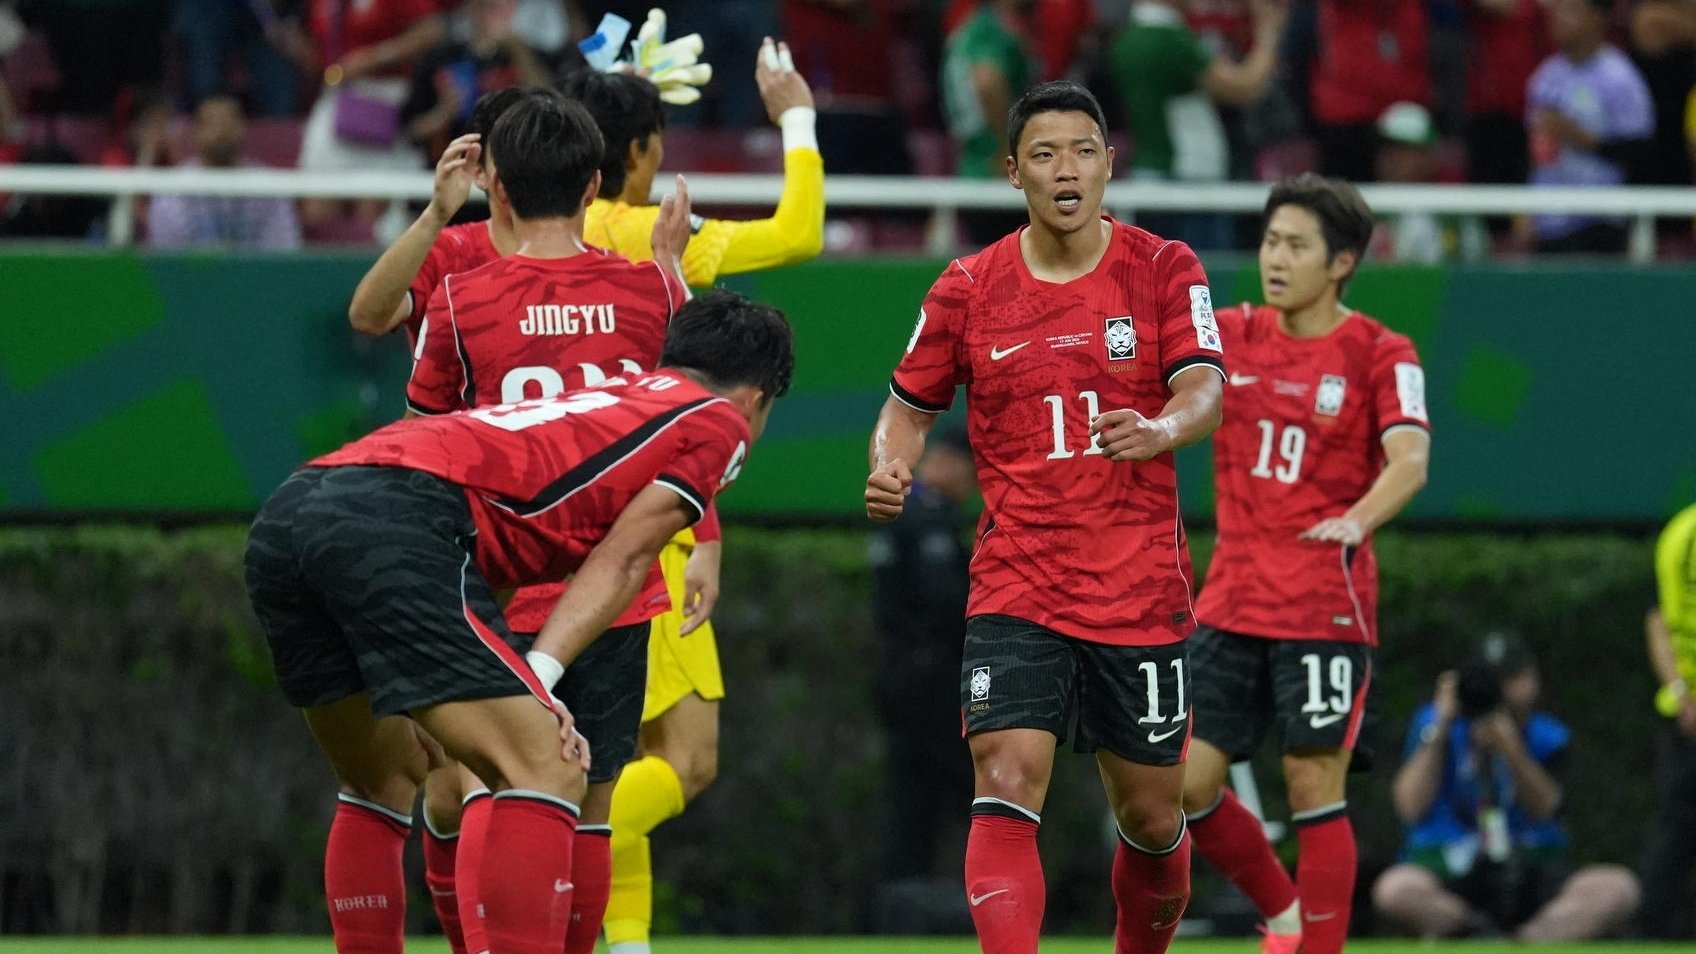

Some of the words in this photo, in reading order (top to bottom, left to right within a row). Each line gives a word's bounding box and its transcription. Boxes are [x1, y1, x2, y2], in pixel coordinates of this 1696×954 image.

[519, 303, 616, 336] JINGYU
[1108, 364, 1137, 373] KOREA
[1044, 390, 1104, 461] 11
[1251, 419, 1306, 484] 19
[1138, 658, 1187, 725] 11
[1301, 653, 1352, 714] 19
